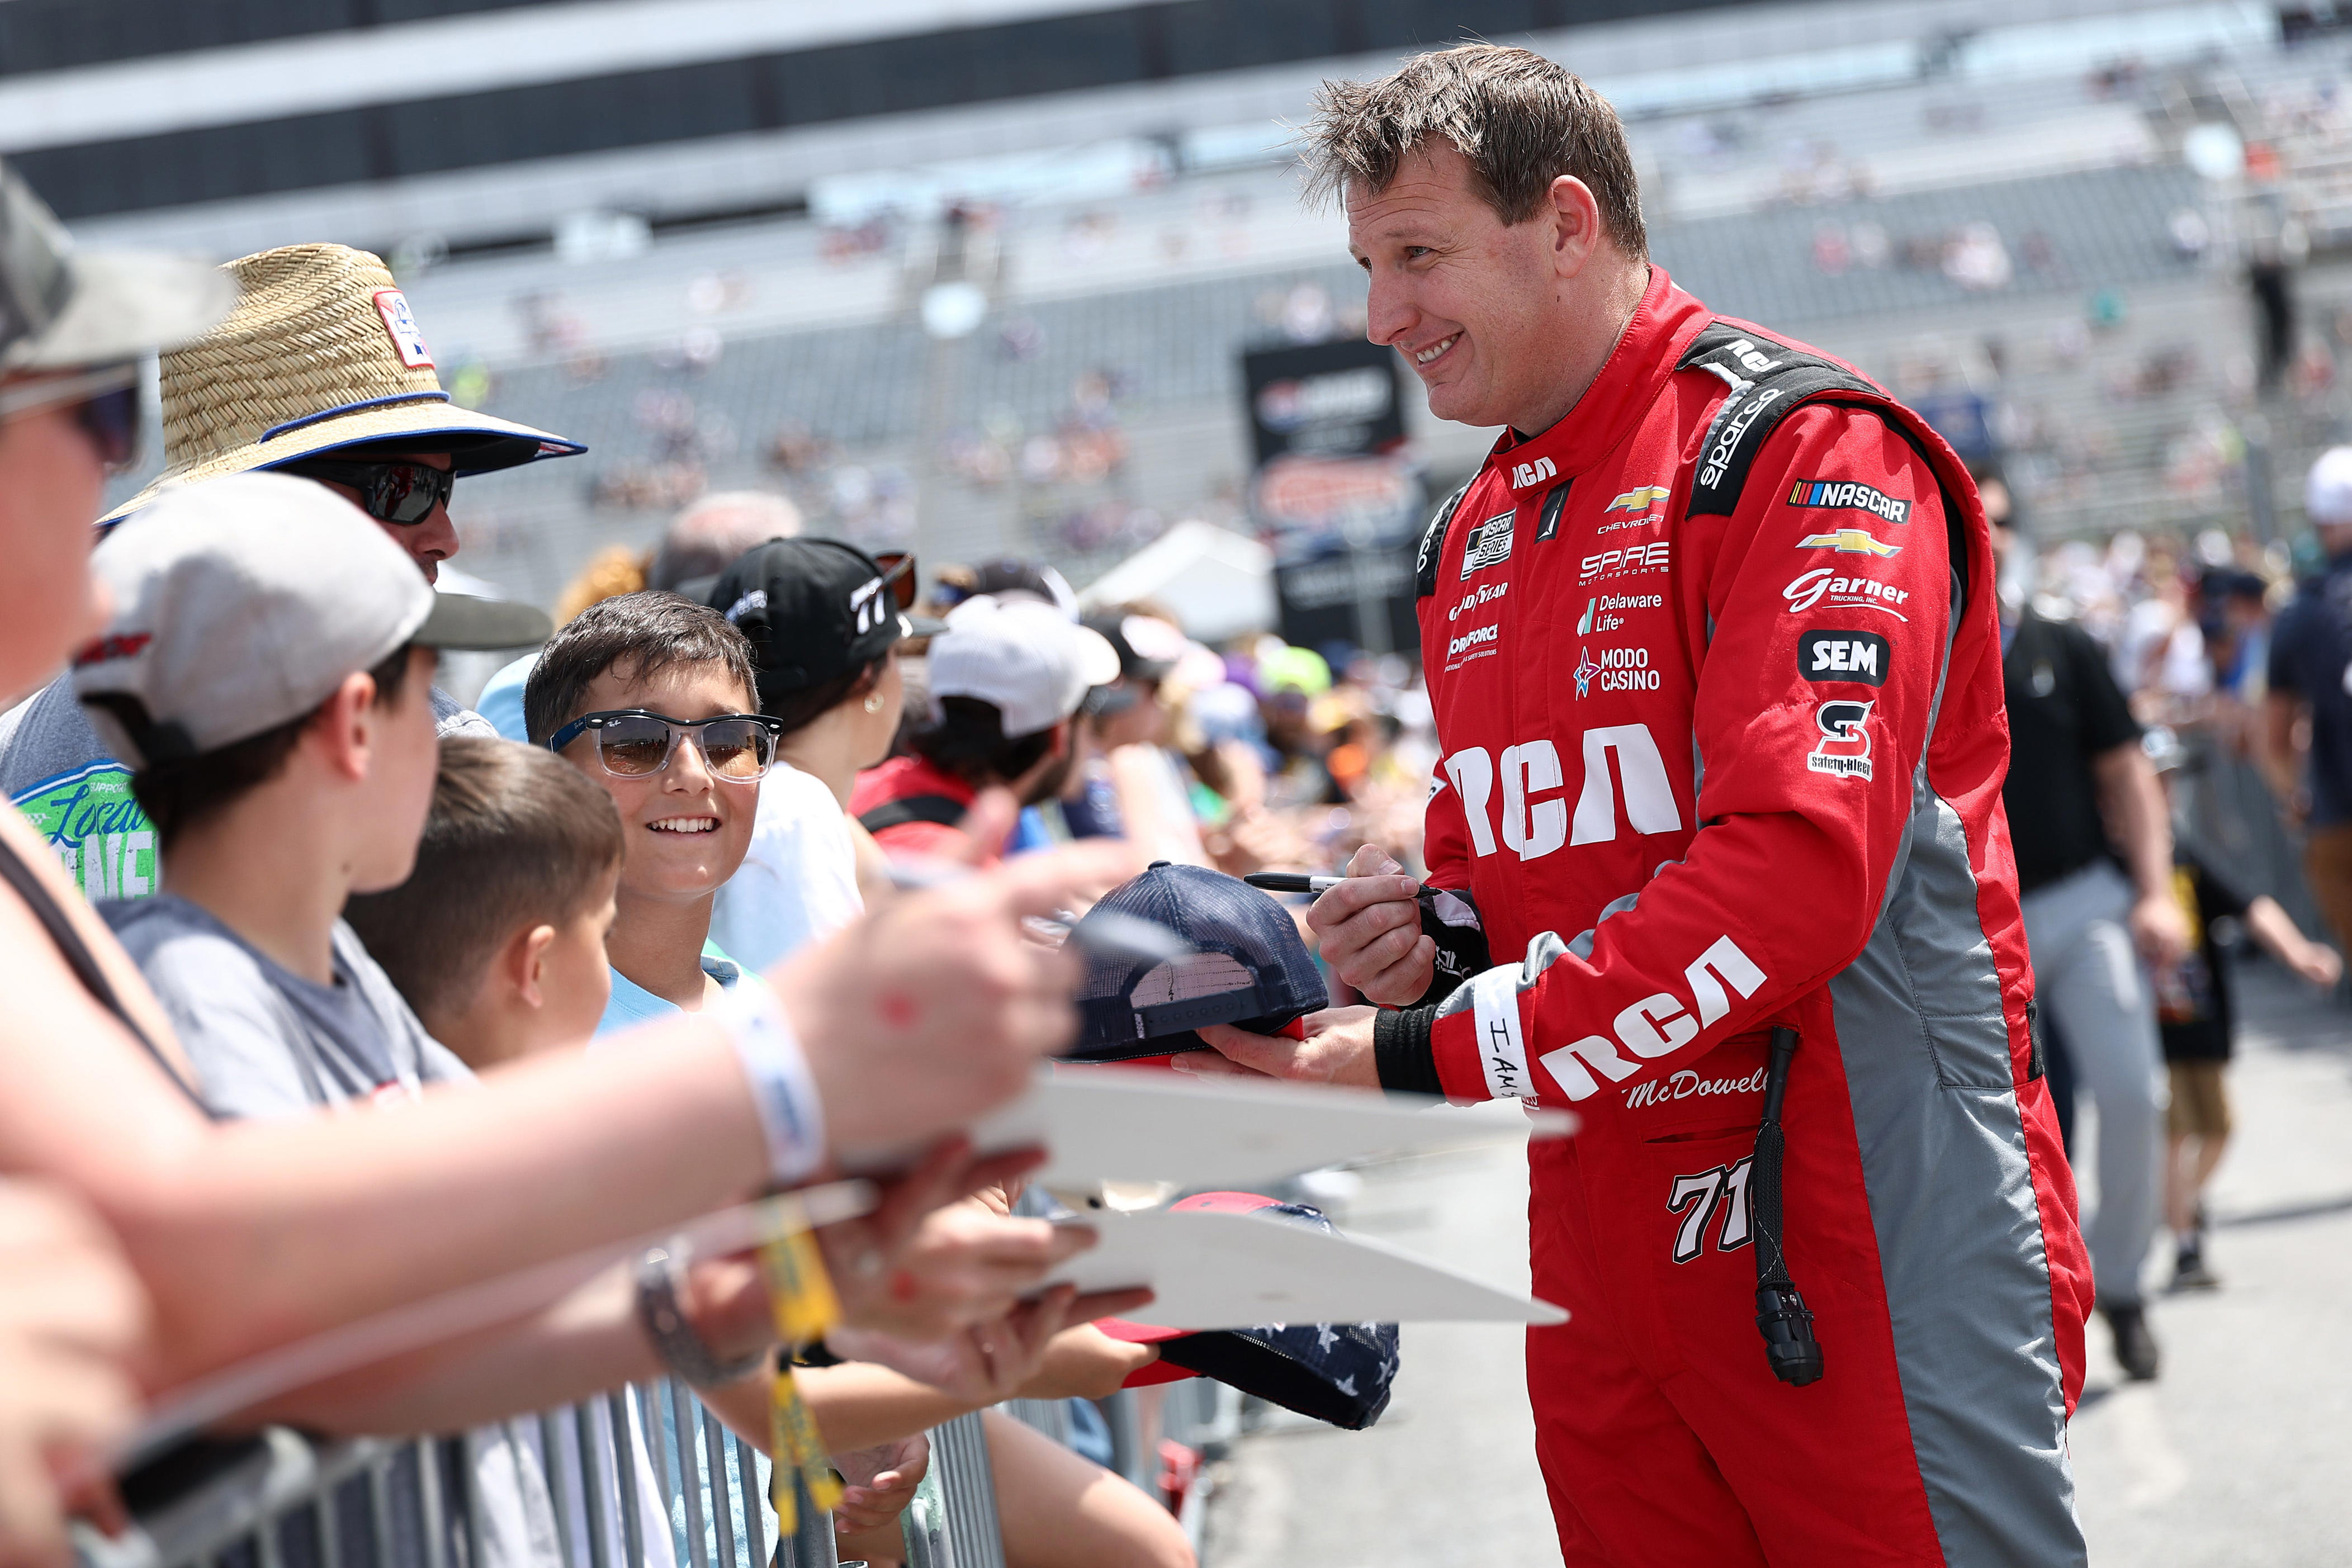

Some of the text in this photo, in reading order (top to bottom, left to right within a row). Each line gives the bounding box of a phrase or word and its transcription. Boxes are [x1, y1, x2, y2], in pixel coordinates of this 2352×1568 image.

[1700, 389, 1786, 490] sparco
[1819, 483, 1906, 522] NASCAR
[1482, 515, 1512, 539] NASCAR
[1597, 513, 1665, 535] CHEVROLET
[1479, 537, 1508, 558] SERIES
[1579, 542, 1670, 579] SPIRE
[1578, 566, 1669, 587] MOTORSPORTS
[1782, 568, 1909, 613] Garner
[1599, 593, 1663, 612] Delaware
[1865, 595, 1878, 605] INC.
[1601, 648, 1649, 670] MODO
[1812, 641, 1878, 677] SEM
[1601, 670, 1660, 691] CASINO
[1443, 723, 1682, 862] RCA
[1490, 1017, 1510, 1053] I
[1539, 934, 1768, 1102] RCA
[1666, 1154, 1754, 1264] 71
